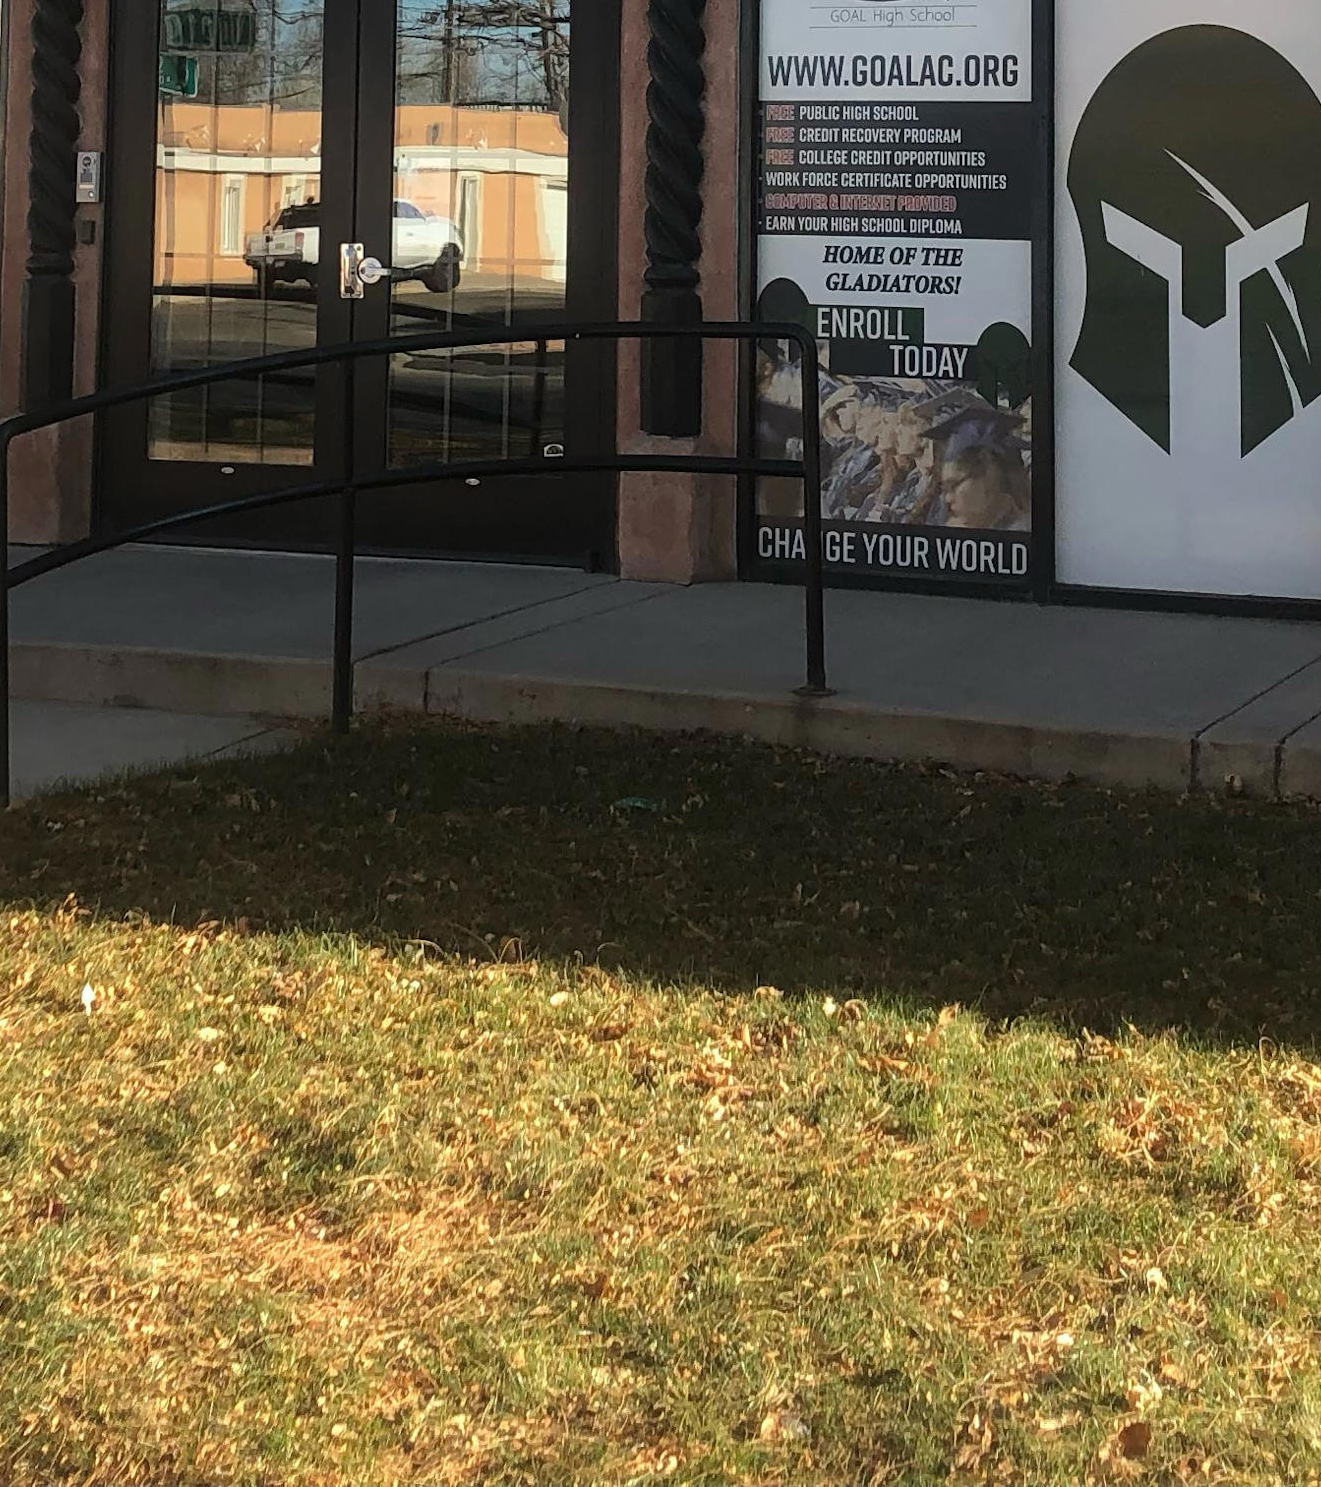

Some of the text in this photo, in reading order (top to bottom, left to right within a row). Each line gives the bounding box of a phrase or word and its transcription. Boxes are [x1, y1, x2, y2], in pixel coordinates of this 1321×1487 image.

[830, 5, 956, 27] GOAL High School
[767, 53, 1019, 88] WWW.GOALAC.ORG
[766, 104, 919, 121] FREE PUBLIC HIGH SCHOOL
[766, 127, 962, 144] FREE CREDIT RECOVERY PROGRAM
[766, 149, 986, 167] FREE COLLEGE CREDIT OPPORTUNITIES
[765, 172, 1007, 190] WORK FORCE CERTIFICATE OPPORTUNITIES
[765, 193, 957, 213] COMPUTER & INTERNET PROVIDED
[766, 216, 962, 234] EARN YOUR HIGH SCHOOL DIPLOMA
[823, 245, 964, 267] HOME OF THE
[825, 273, 962, 295] GLADIATORS!
[817, 307, 910, 340] ENROLL
[889, 344, 968, 378] TODAY
[758, 526, 1028, 575] CHAGE YOUR WORLD
